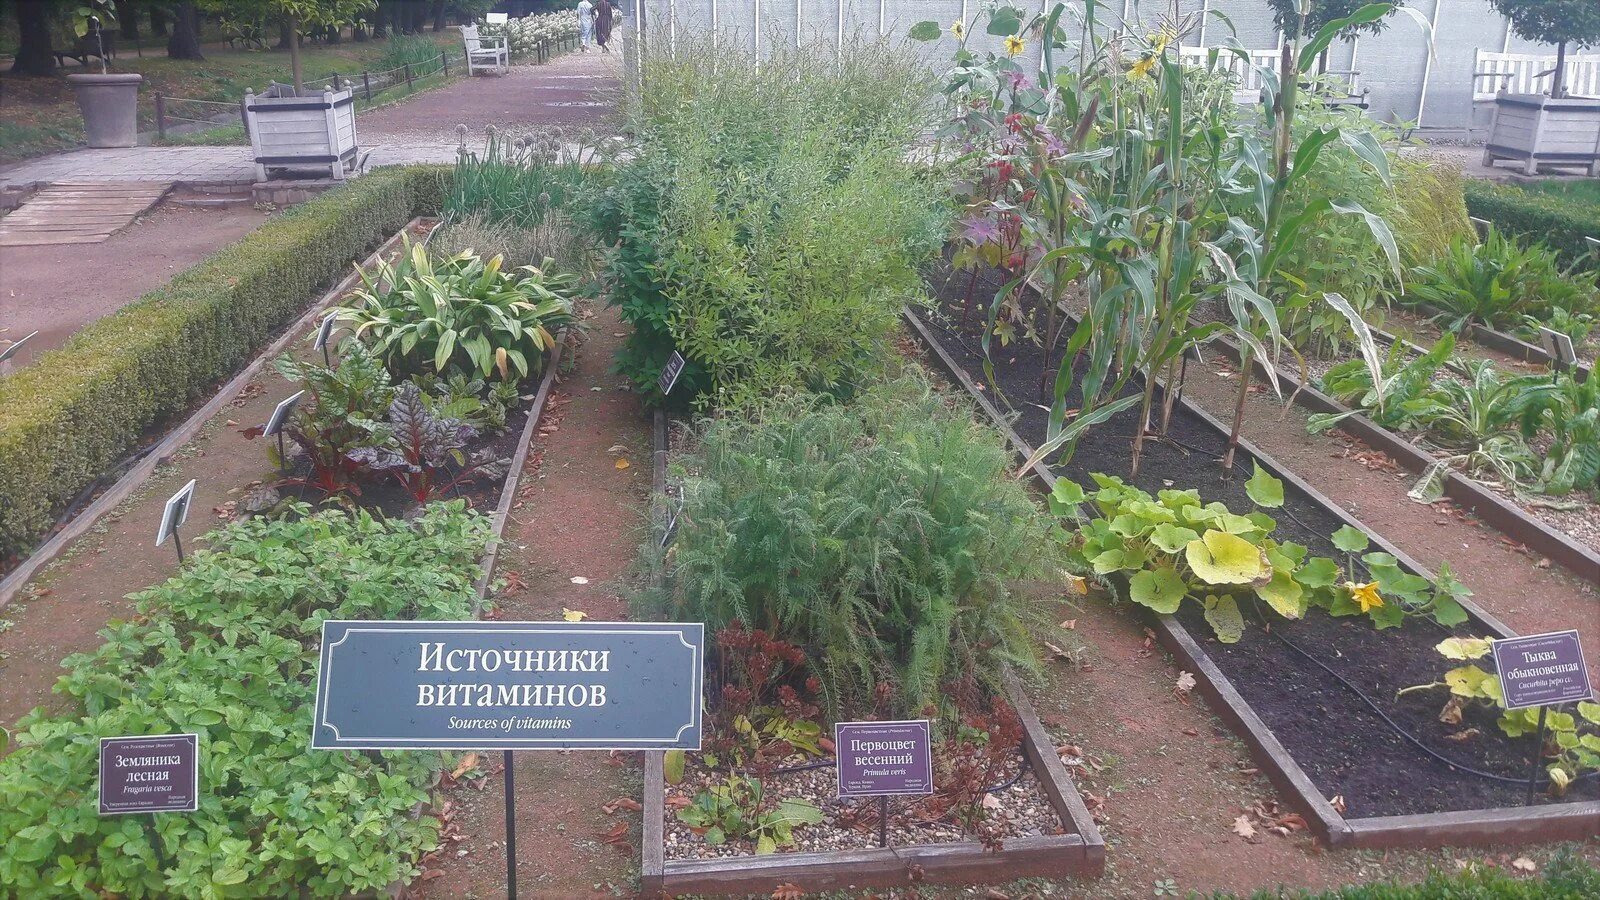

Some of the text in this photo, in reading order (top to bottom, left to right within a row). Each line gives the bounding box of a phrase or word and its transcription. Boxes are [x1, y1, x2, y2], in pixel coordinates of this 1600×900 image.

[417, 642, 611, 673] Источники
[1522, 650, 1557, 663] Тыква
[1507, 662, 1579, 680] обыкновенная
[416, 683, 607, 708] витаминов
[448, 715, 571, 733] Sources of vitamins
[851, 739, 916, 754] Первоцвет
[115, 754, 181, 768] Земляника
[855, 752, 913, 766] весенний
[126, 770, 170, 782] лесная
[863, 768, 907, 777] Primula veris
[123, 785, 152, 795] Fragaria
